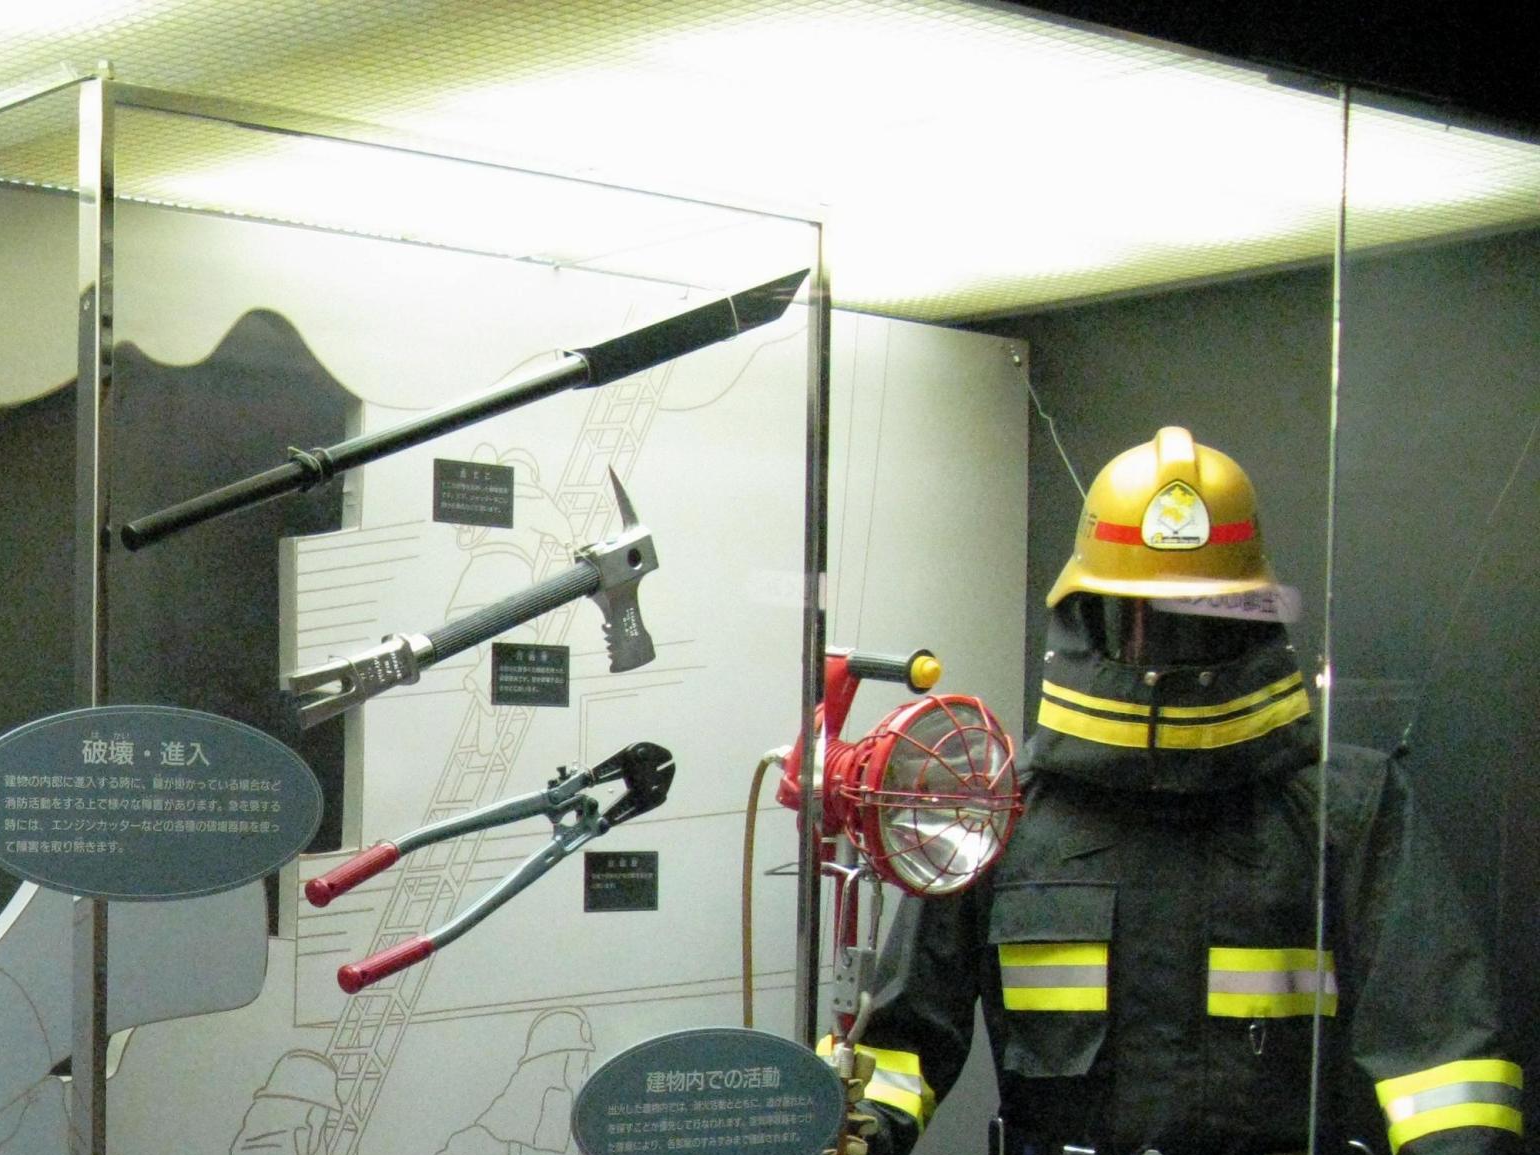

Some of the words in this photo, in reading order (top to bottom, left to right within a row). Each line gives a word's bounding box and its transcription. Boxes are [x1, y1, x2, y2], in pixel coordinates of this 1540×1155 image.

[82, 739, 210, 767] 破壊・進入
[646, 1066, 780, 1093] 建物内での活動
